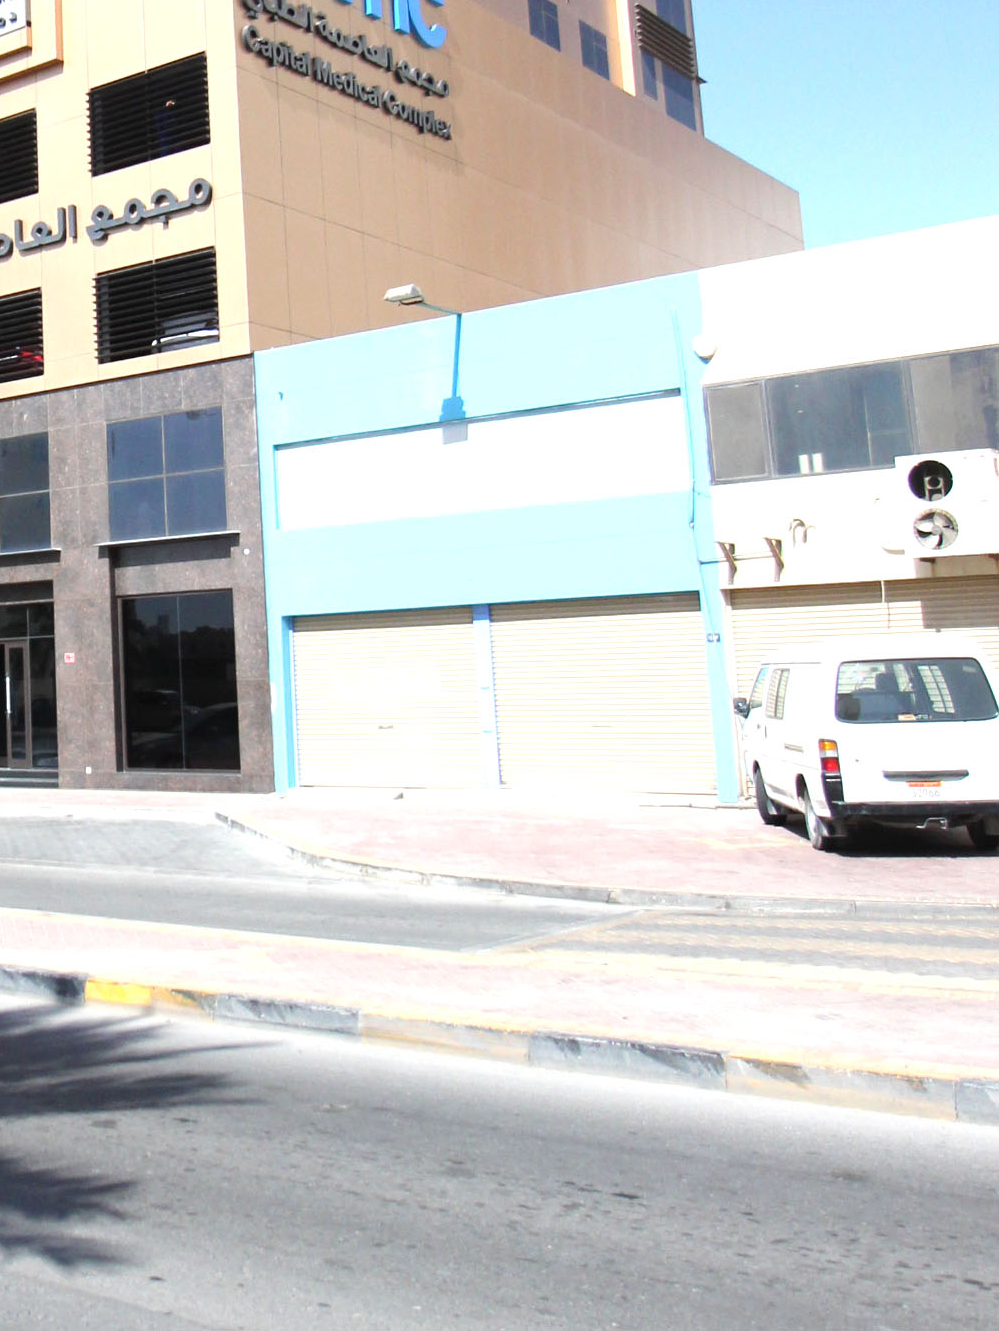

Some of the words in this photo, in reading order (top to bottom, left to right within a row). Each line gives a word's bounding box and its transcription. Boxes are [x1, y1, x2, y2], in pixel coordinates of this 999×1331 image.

[314, 11, 394, 73] العاصمة
[241, 23, 311, 77] Capital
[313, 55, 383, 110] Medical
[383, 89, 452, 141] Complex
[397, 58, 450, 99] مجمع
[85, 176, 213, 246] مجمع
